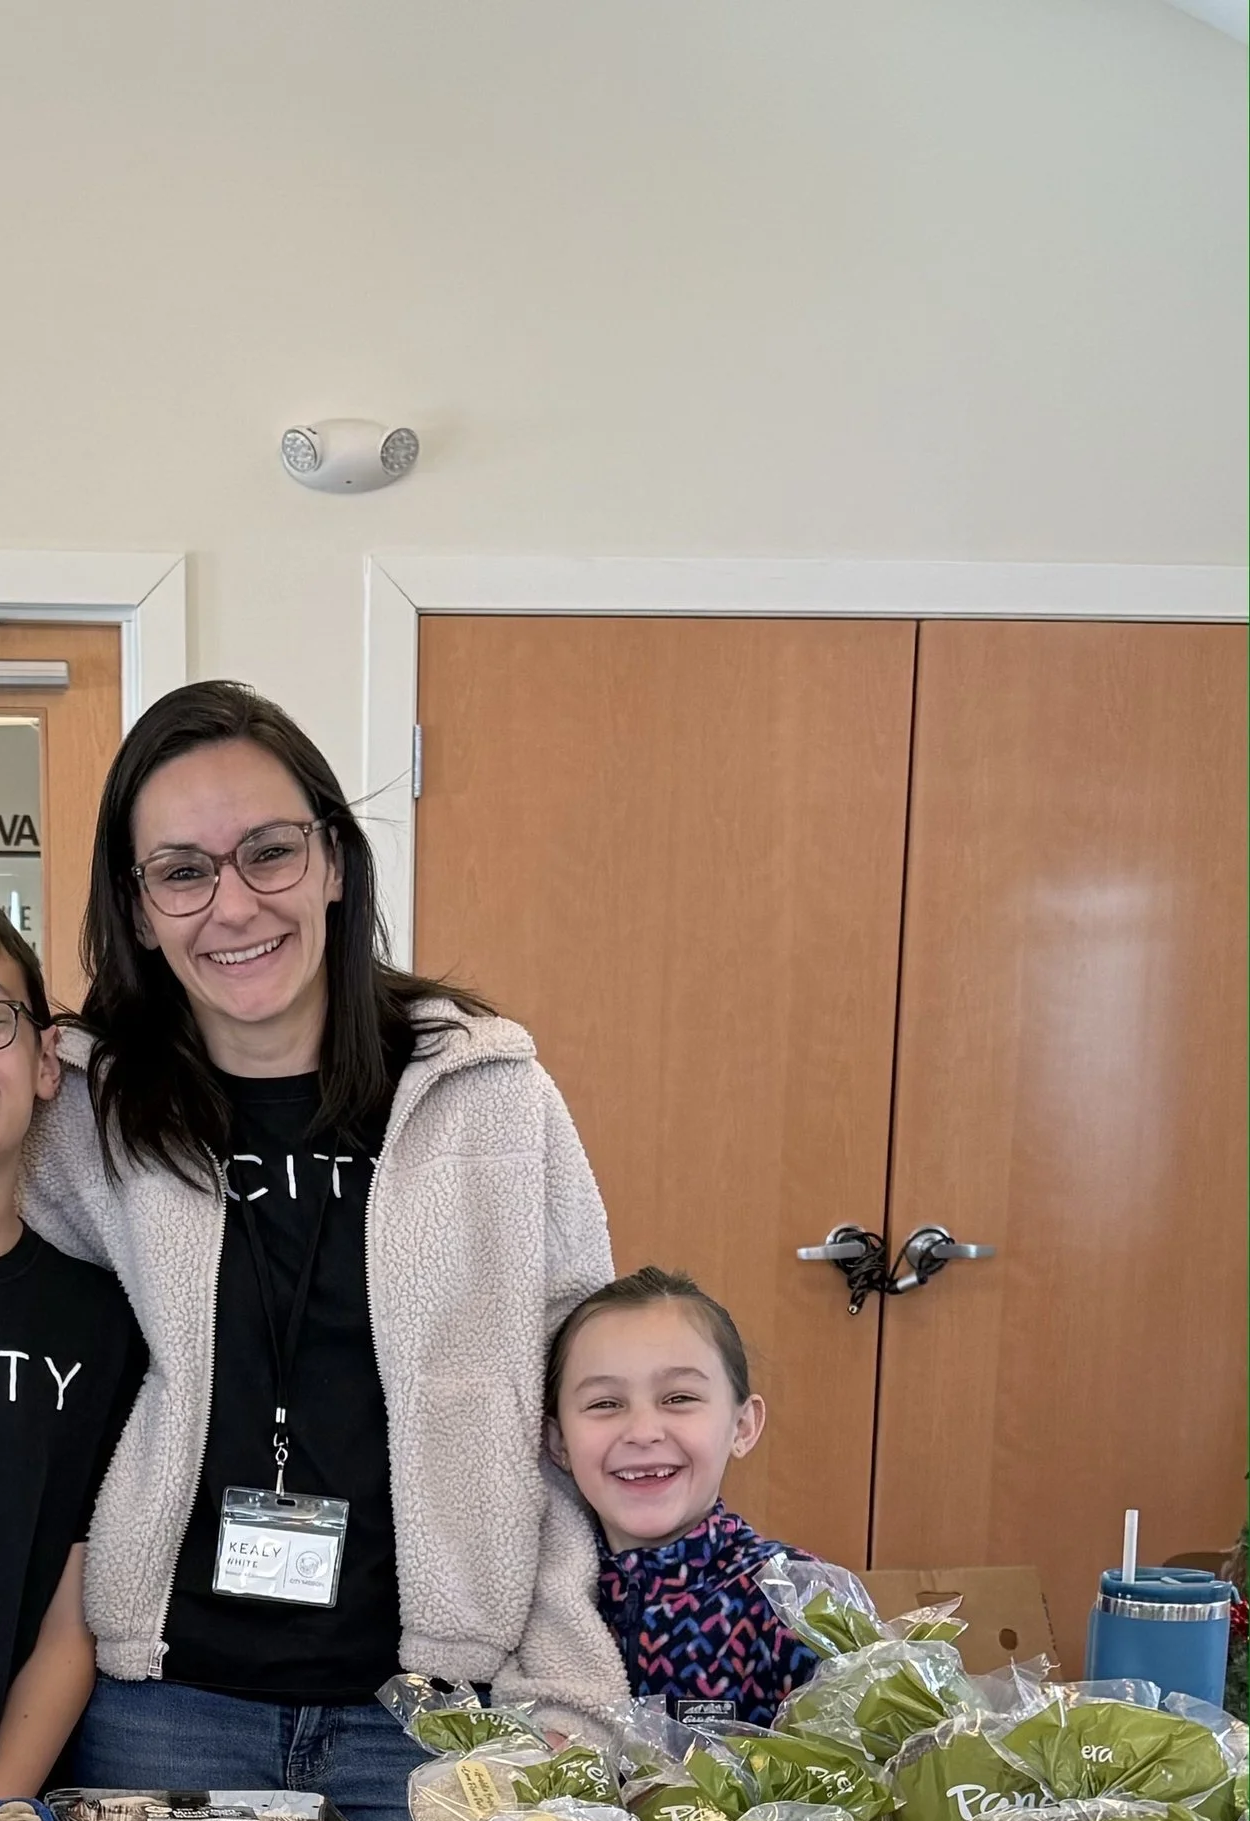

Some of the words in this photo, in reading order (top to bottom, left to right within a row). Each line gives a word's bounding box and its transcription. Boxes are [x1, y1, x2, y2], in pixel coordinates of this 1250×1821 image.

[221, 1153, 379, 1201] CIT
[229, 1541, 282, 1558] KEALY
[226, 1557, 258, 1569] WHITE
